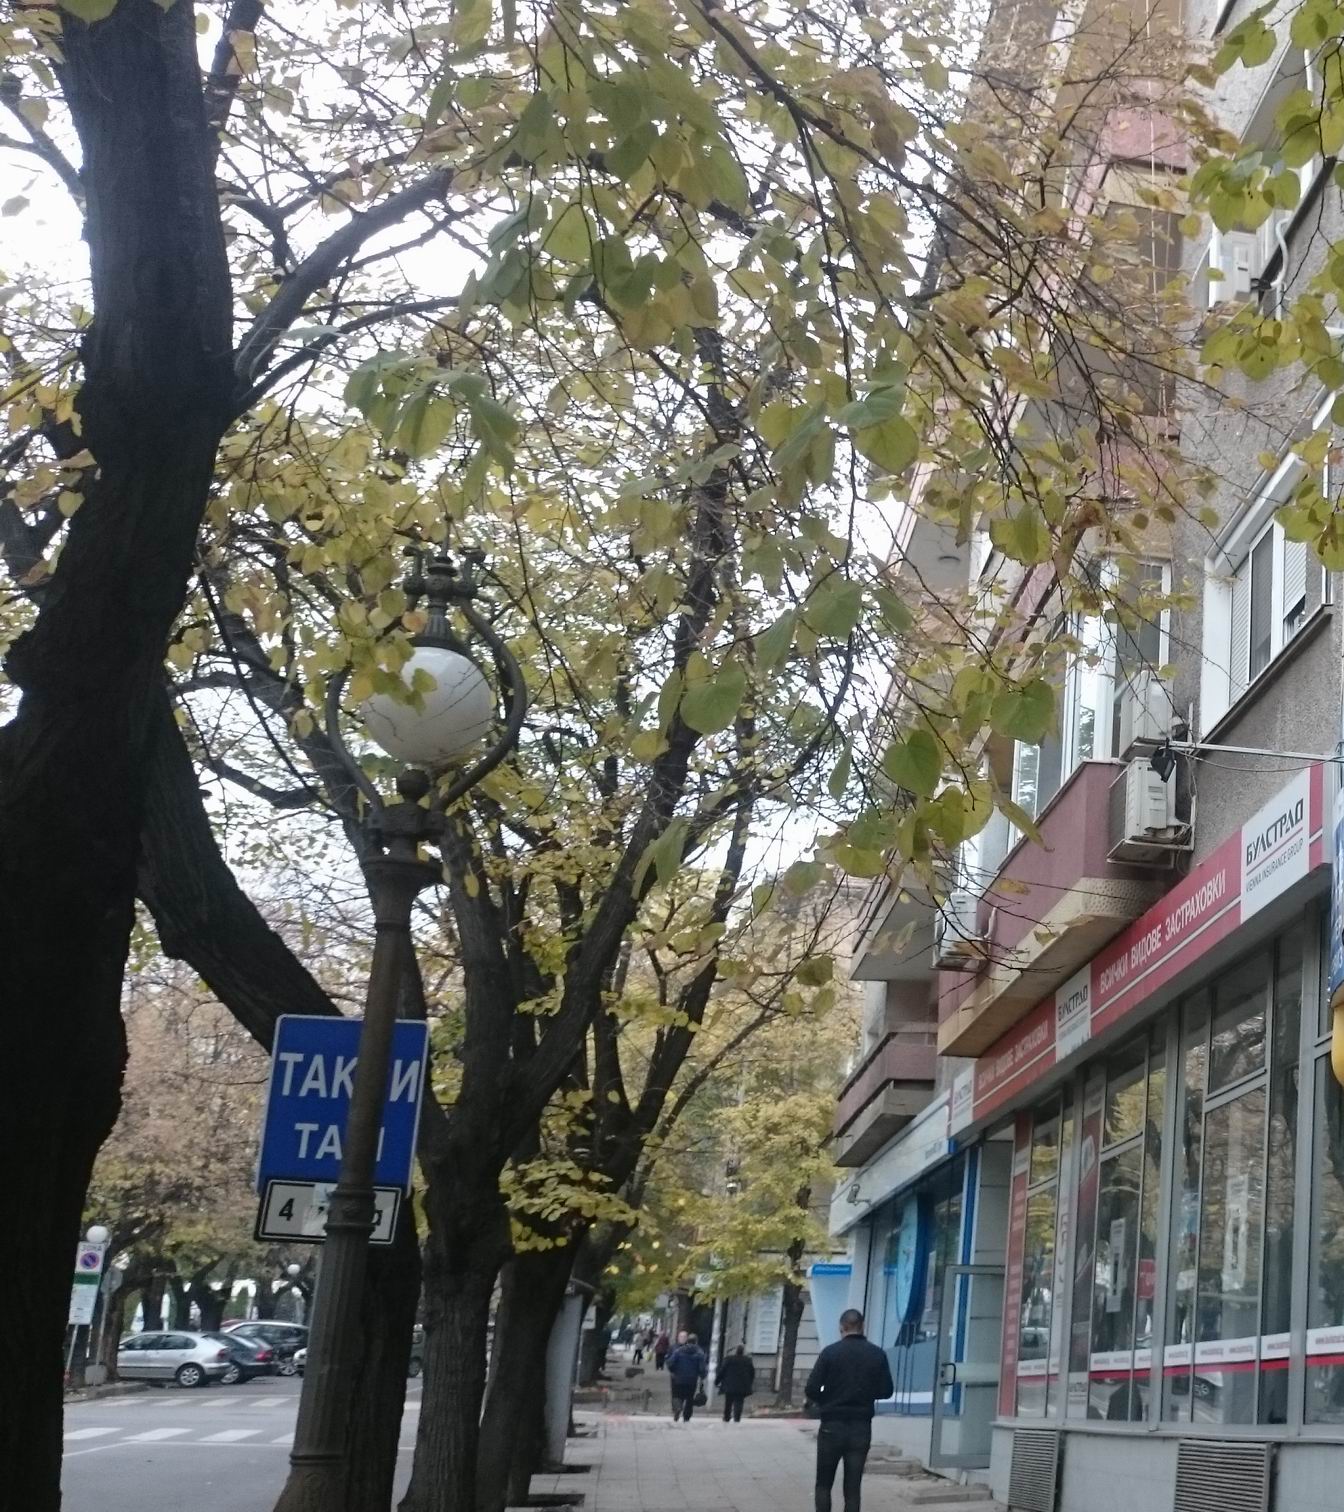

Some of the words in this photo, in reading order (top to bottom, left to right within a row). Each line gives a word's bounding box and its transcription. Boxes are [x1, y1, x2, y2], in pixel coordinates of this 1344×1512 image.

[1246, 797, 1304, 867] БУЛСТРАД
[1131, 924, 1162, 970] ВИДОВЕ
[1165, 869, 1226, 942] ЗАСТРАХОВКИ
[278, 1052, 421, 1103] ТАКИ
[294, 1122, 385, 1163] TAI
[278, 1197, 294, 1222] 4
